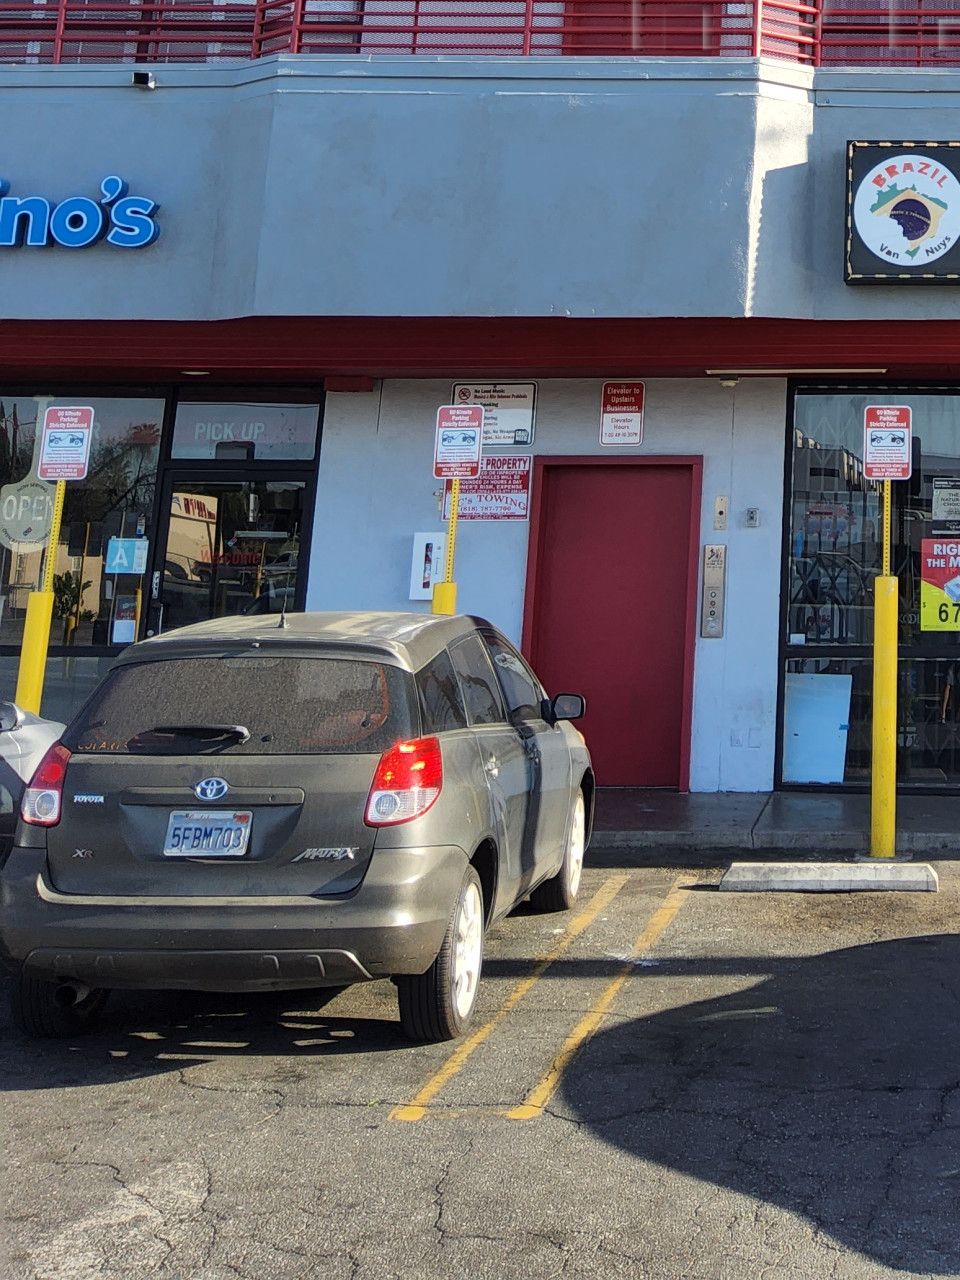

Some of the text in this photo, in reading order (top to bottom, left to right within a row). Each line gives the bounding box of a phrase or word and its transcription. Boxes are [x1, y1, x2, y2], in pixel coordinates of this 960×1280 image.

[872, 161, 949, 189] BRAZIL
[0, 175, 156, 247] no's
[878, 235, 952, 260] Van Nuys
[607, 387, 632, 395] Elevator
[611, 395, 635, 404] Upstairs
[606, 404, 639, 412] Businesses
[194, 422, 265, 441] PICK UP
[485, 458, 527, 470] PROPERTY
[476, 494, 526, 511] TOWING
[112, 547, 130, 567] A
[926, 557, 946, 567] THE
[73, 795, 105, 803] TOYOTA
[171, 826, 244, 850] 5FBM703
[291, 847, 360, 862] MATRIX
